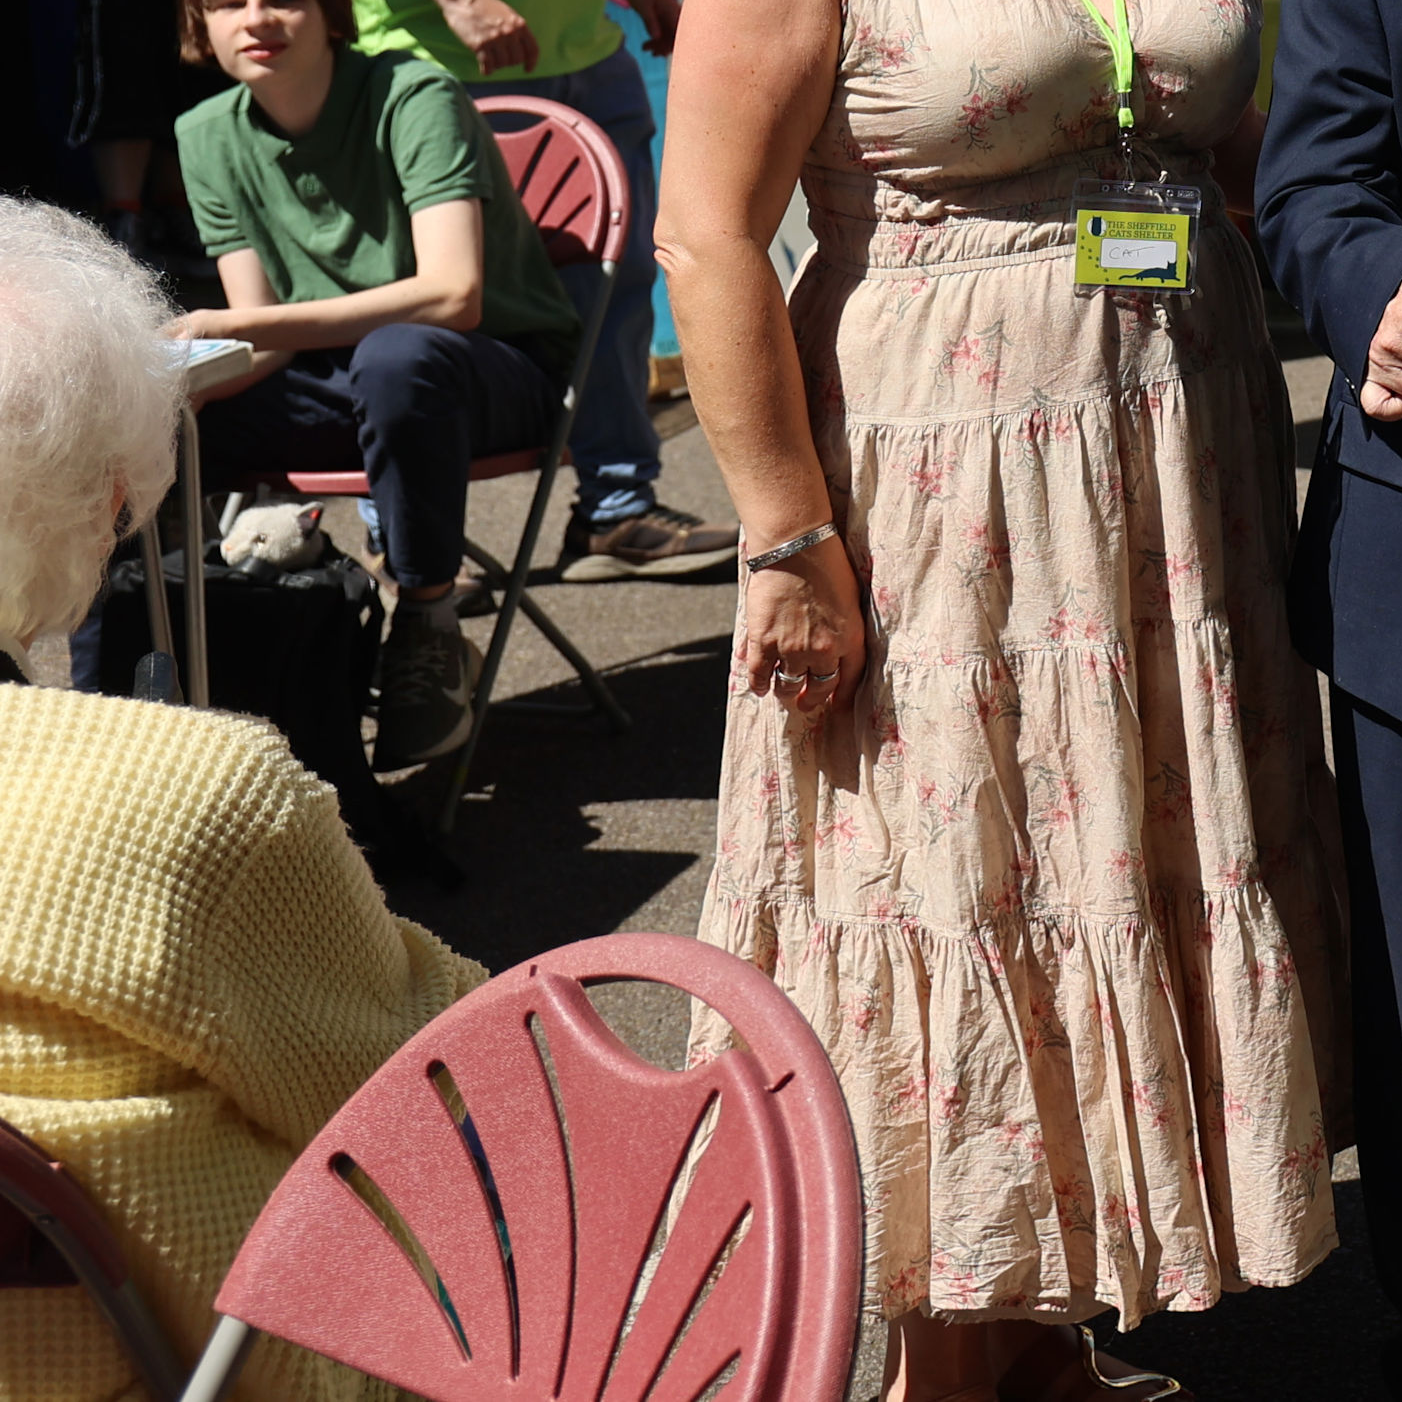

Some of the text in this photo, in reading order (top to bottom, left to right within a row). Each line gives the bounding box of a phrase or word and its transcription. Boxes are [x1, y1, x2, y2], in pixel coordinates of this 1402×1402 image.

[1107, 221, 1177, 232] THE SHEFFIELD
[1109, 229, 1174, 240] CATS SHELTER
[1109, 246, 1156, 260] CAT
